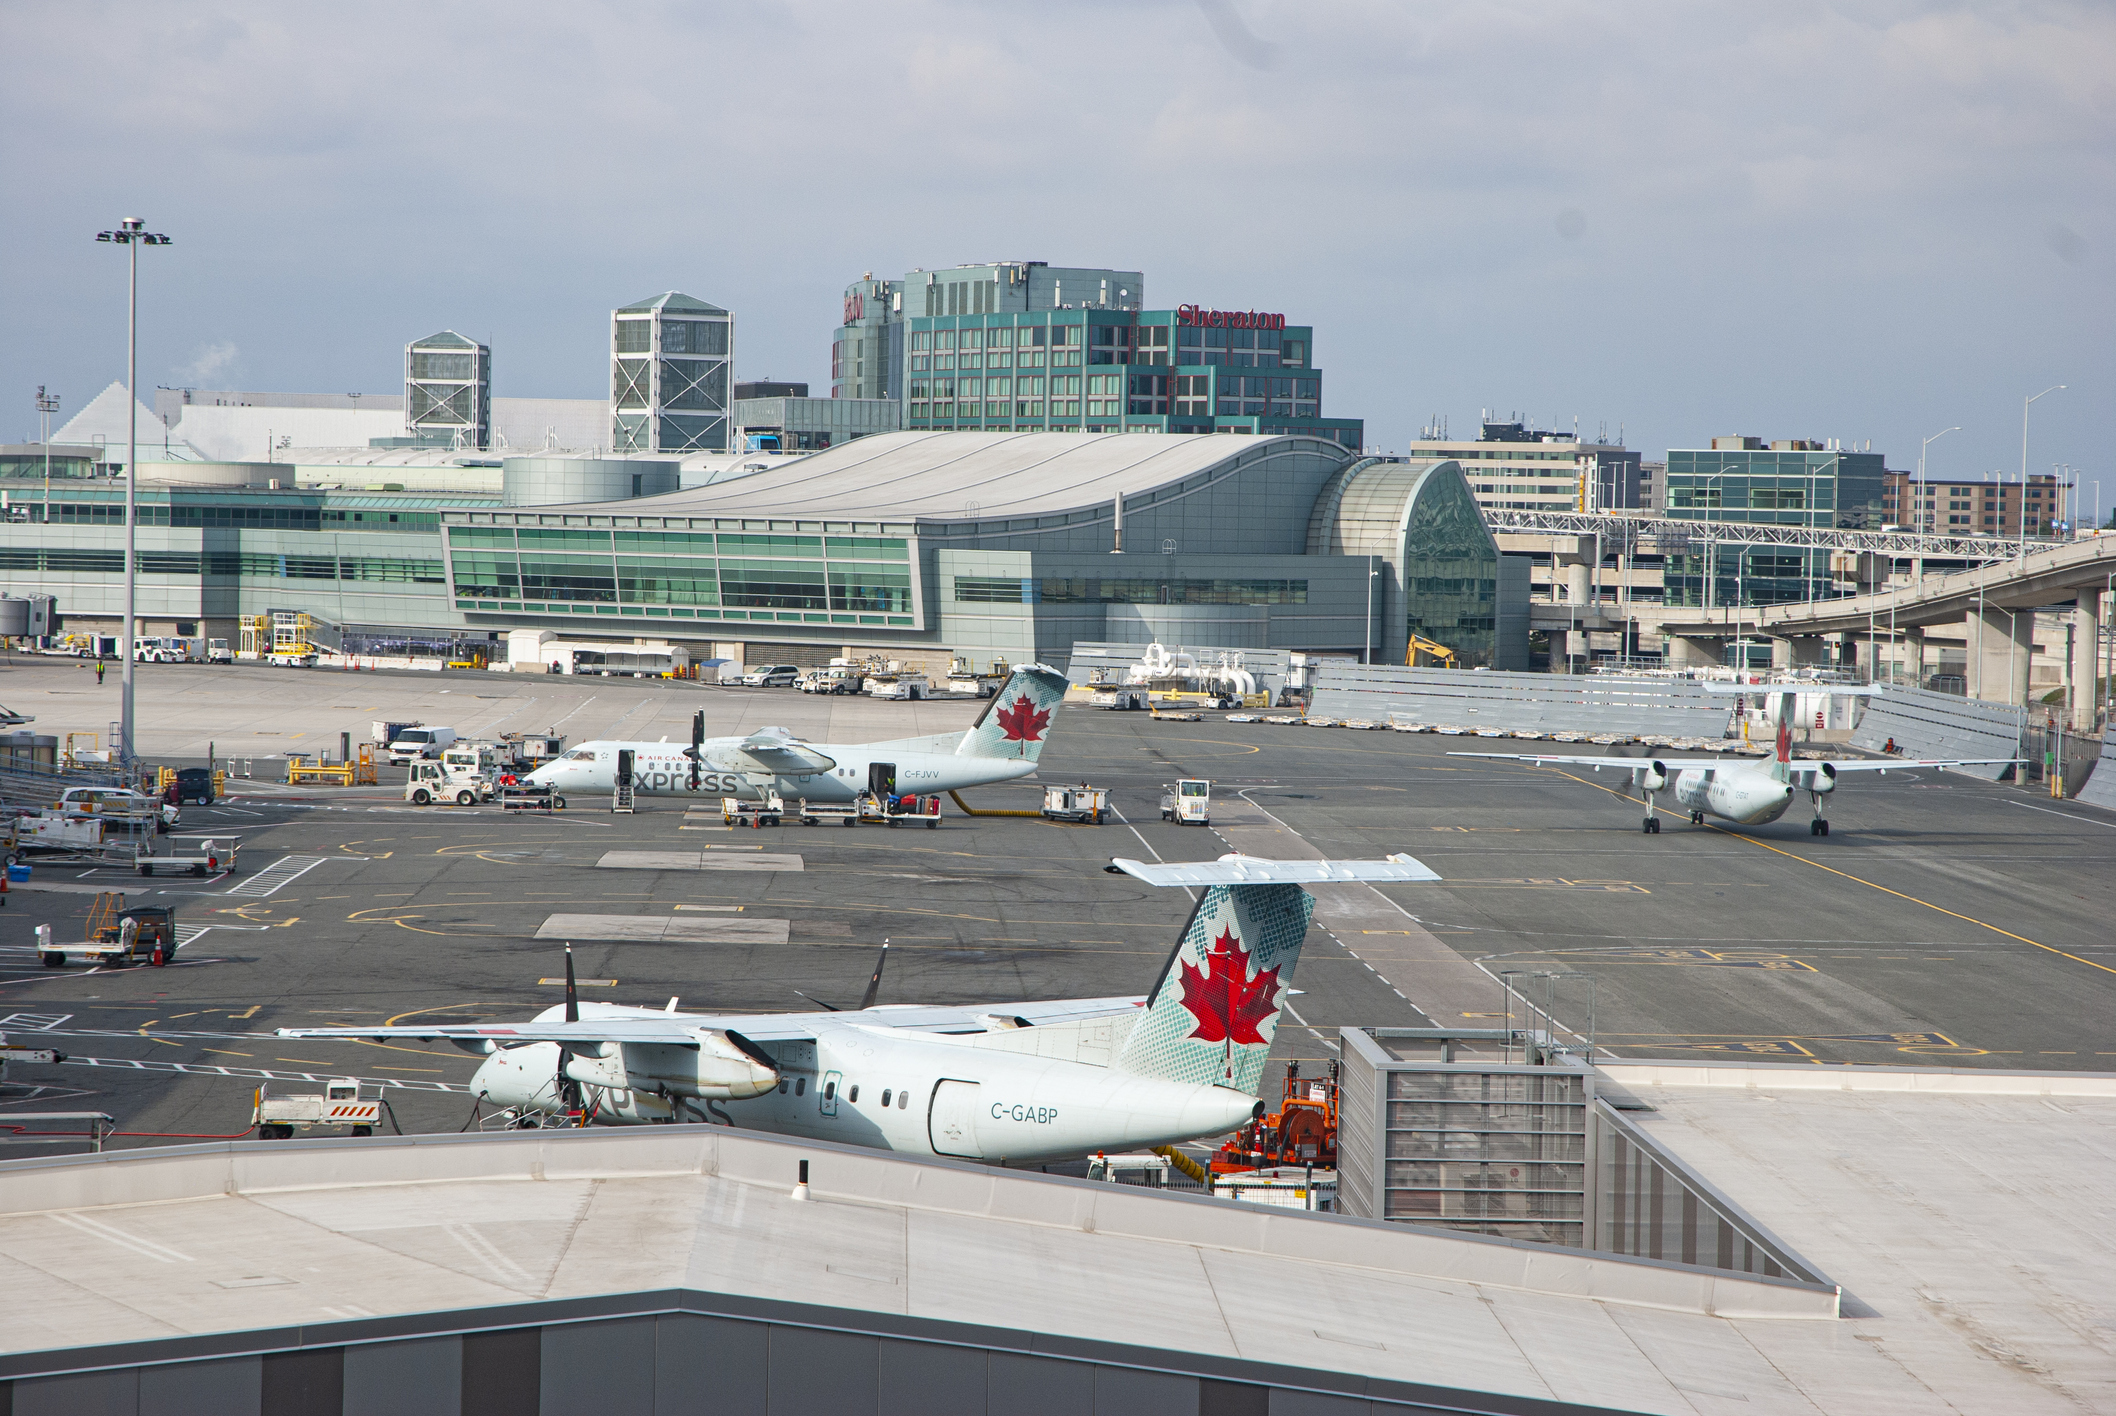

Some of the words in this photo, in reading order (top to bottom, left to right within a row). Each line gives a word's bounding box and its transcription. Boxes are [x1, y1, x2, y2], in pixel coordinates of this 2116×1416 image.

[1178, 304, 1286, 330] Sheraton
[634, 771, 739, 793] xpress
[904, 770, 939, 779] C-FJVV
[991, 1102, 1058, 1125] C-GABP
